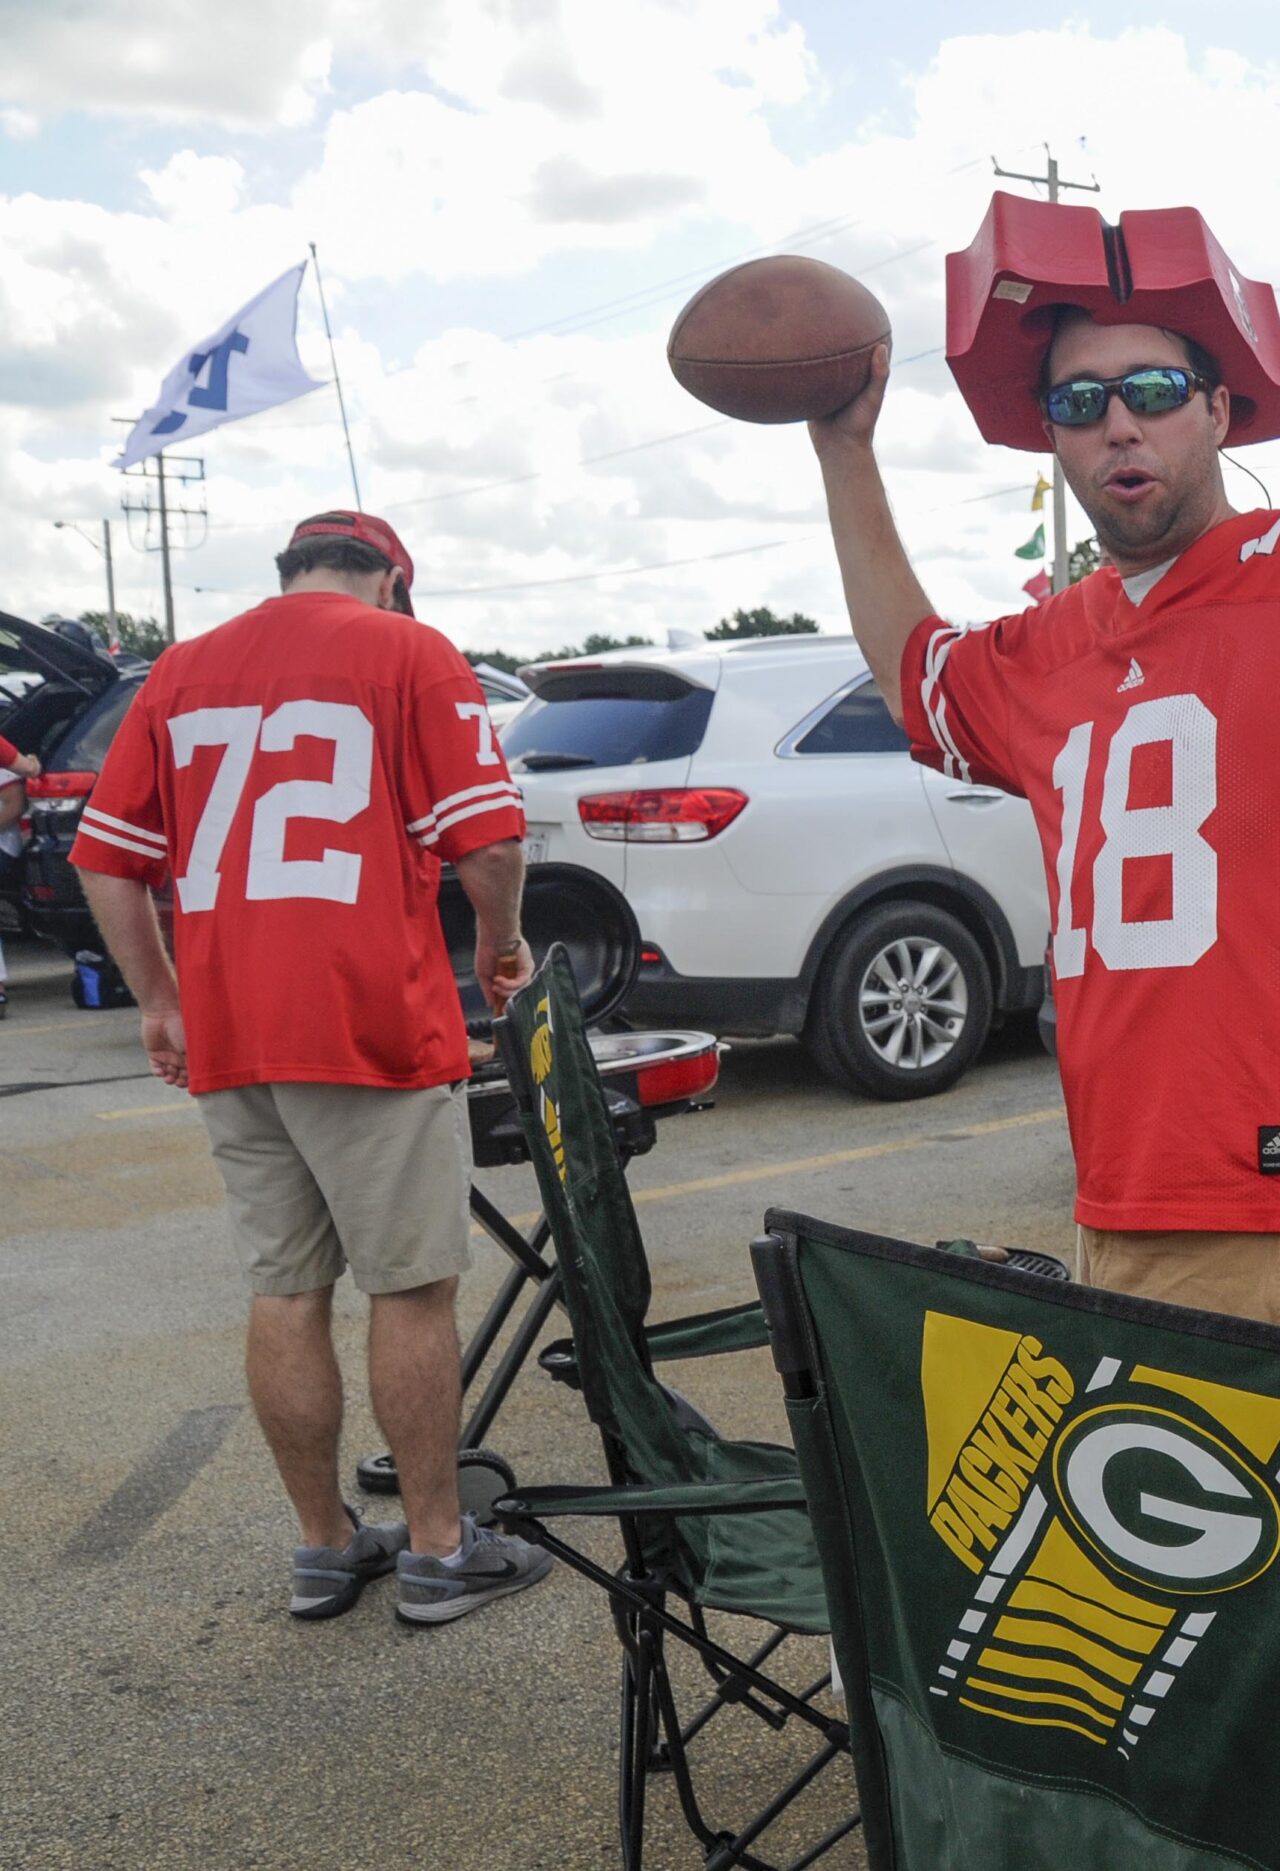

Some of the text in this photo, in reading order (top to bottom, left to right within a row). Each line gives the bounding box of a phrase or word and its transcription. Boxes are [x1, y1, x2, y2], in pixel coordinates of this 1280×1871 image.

[167, 699, 373, 913] 72
[1053, 693, 1218, 980] 18
[930, 1335, 1078, 1574] PACKERS
[1066, 1422, 1262, 1579] G
